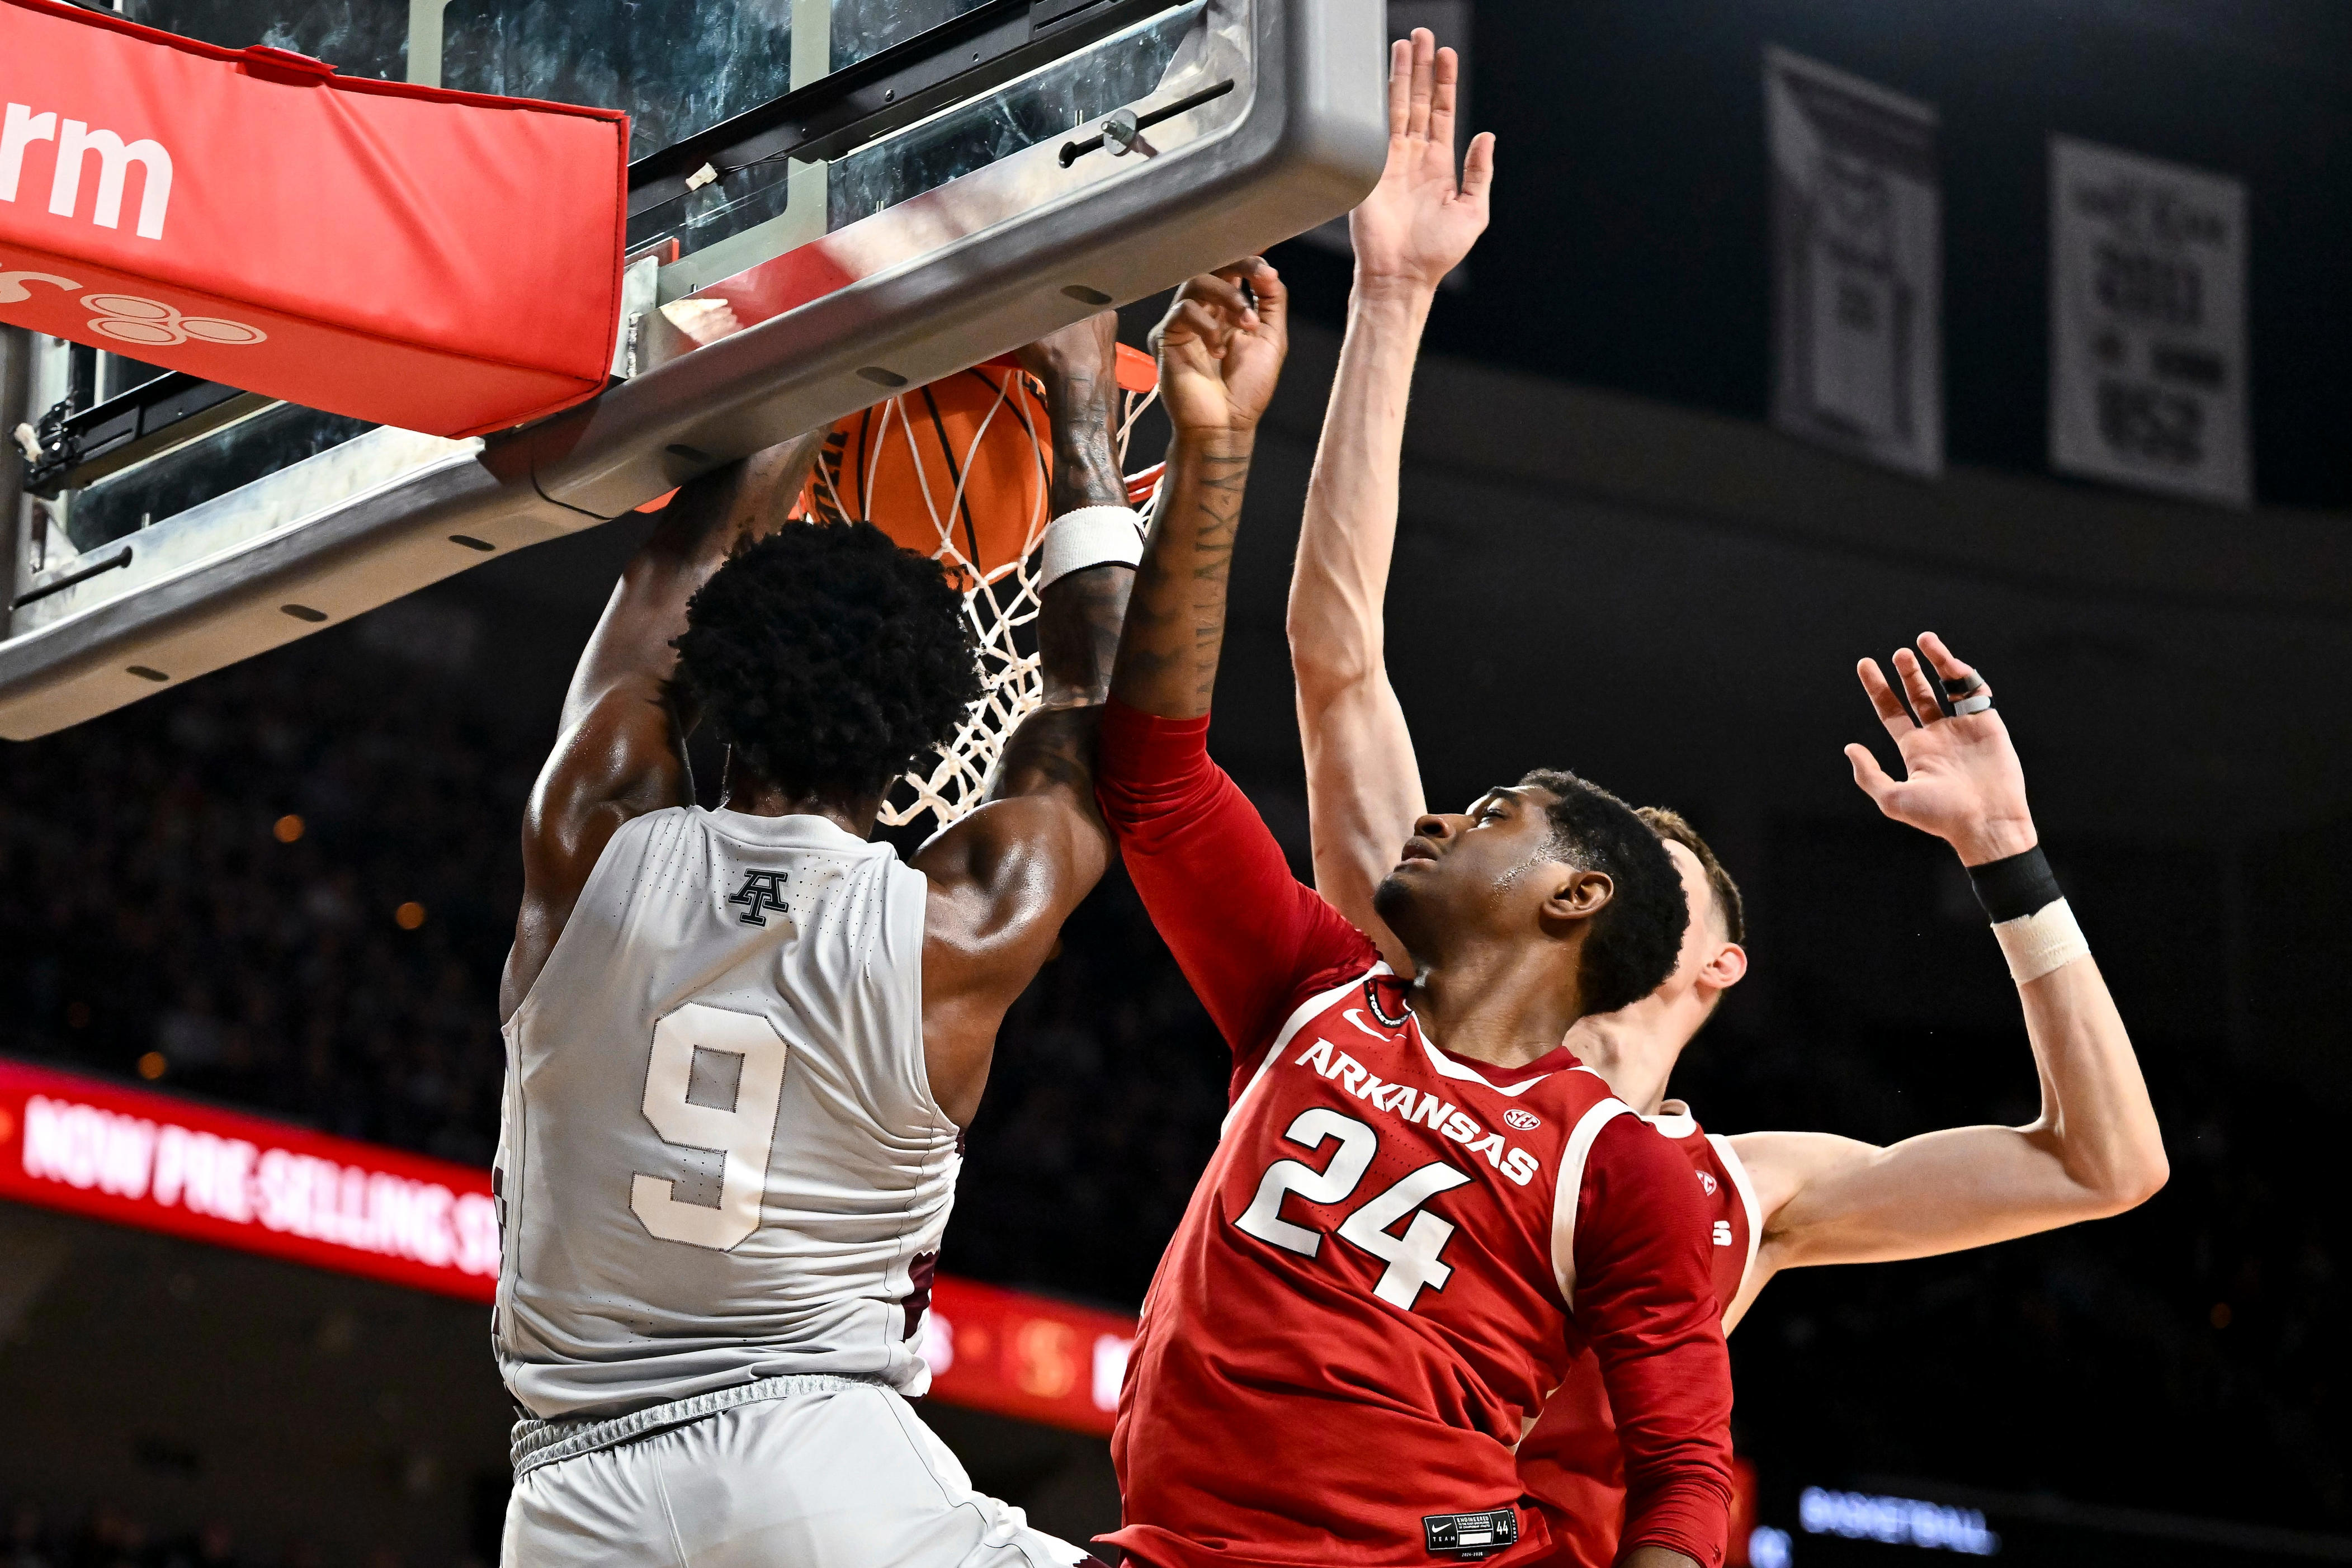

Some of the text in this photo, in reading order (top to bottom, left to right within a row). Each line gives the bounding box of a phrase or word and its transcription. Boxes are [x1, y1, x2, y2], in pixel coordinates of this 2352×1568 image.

[24, 1095, 157, 1199] NOW
[629, 1000, 790, 1253] 9
[1294, 1037, 1539, 1187] ARKANSAS
[1505, 1110, 1539, 1128] SEC
[1232, 1107, 1475, 1312] 24
[1496, 1520, 1509, 1535] 44
